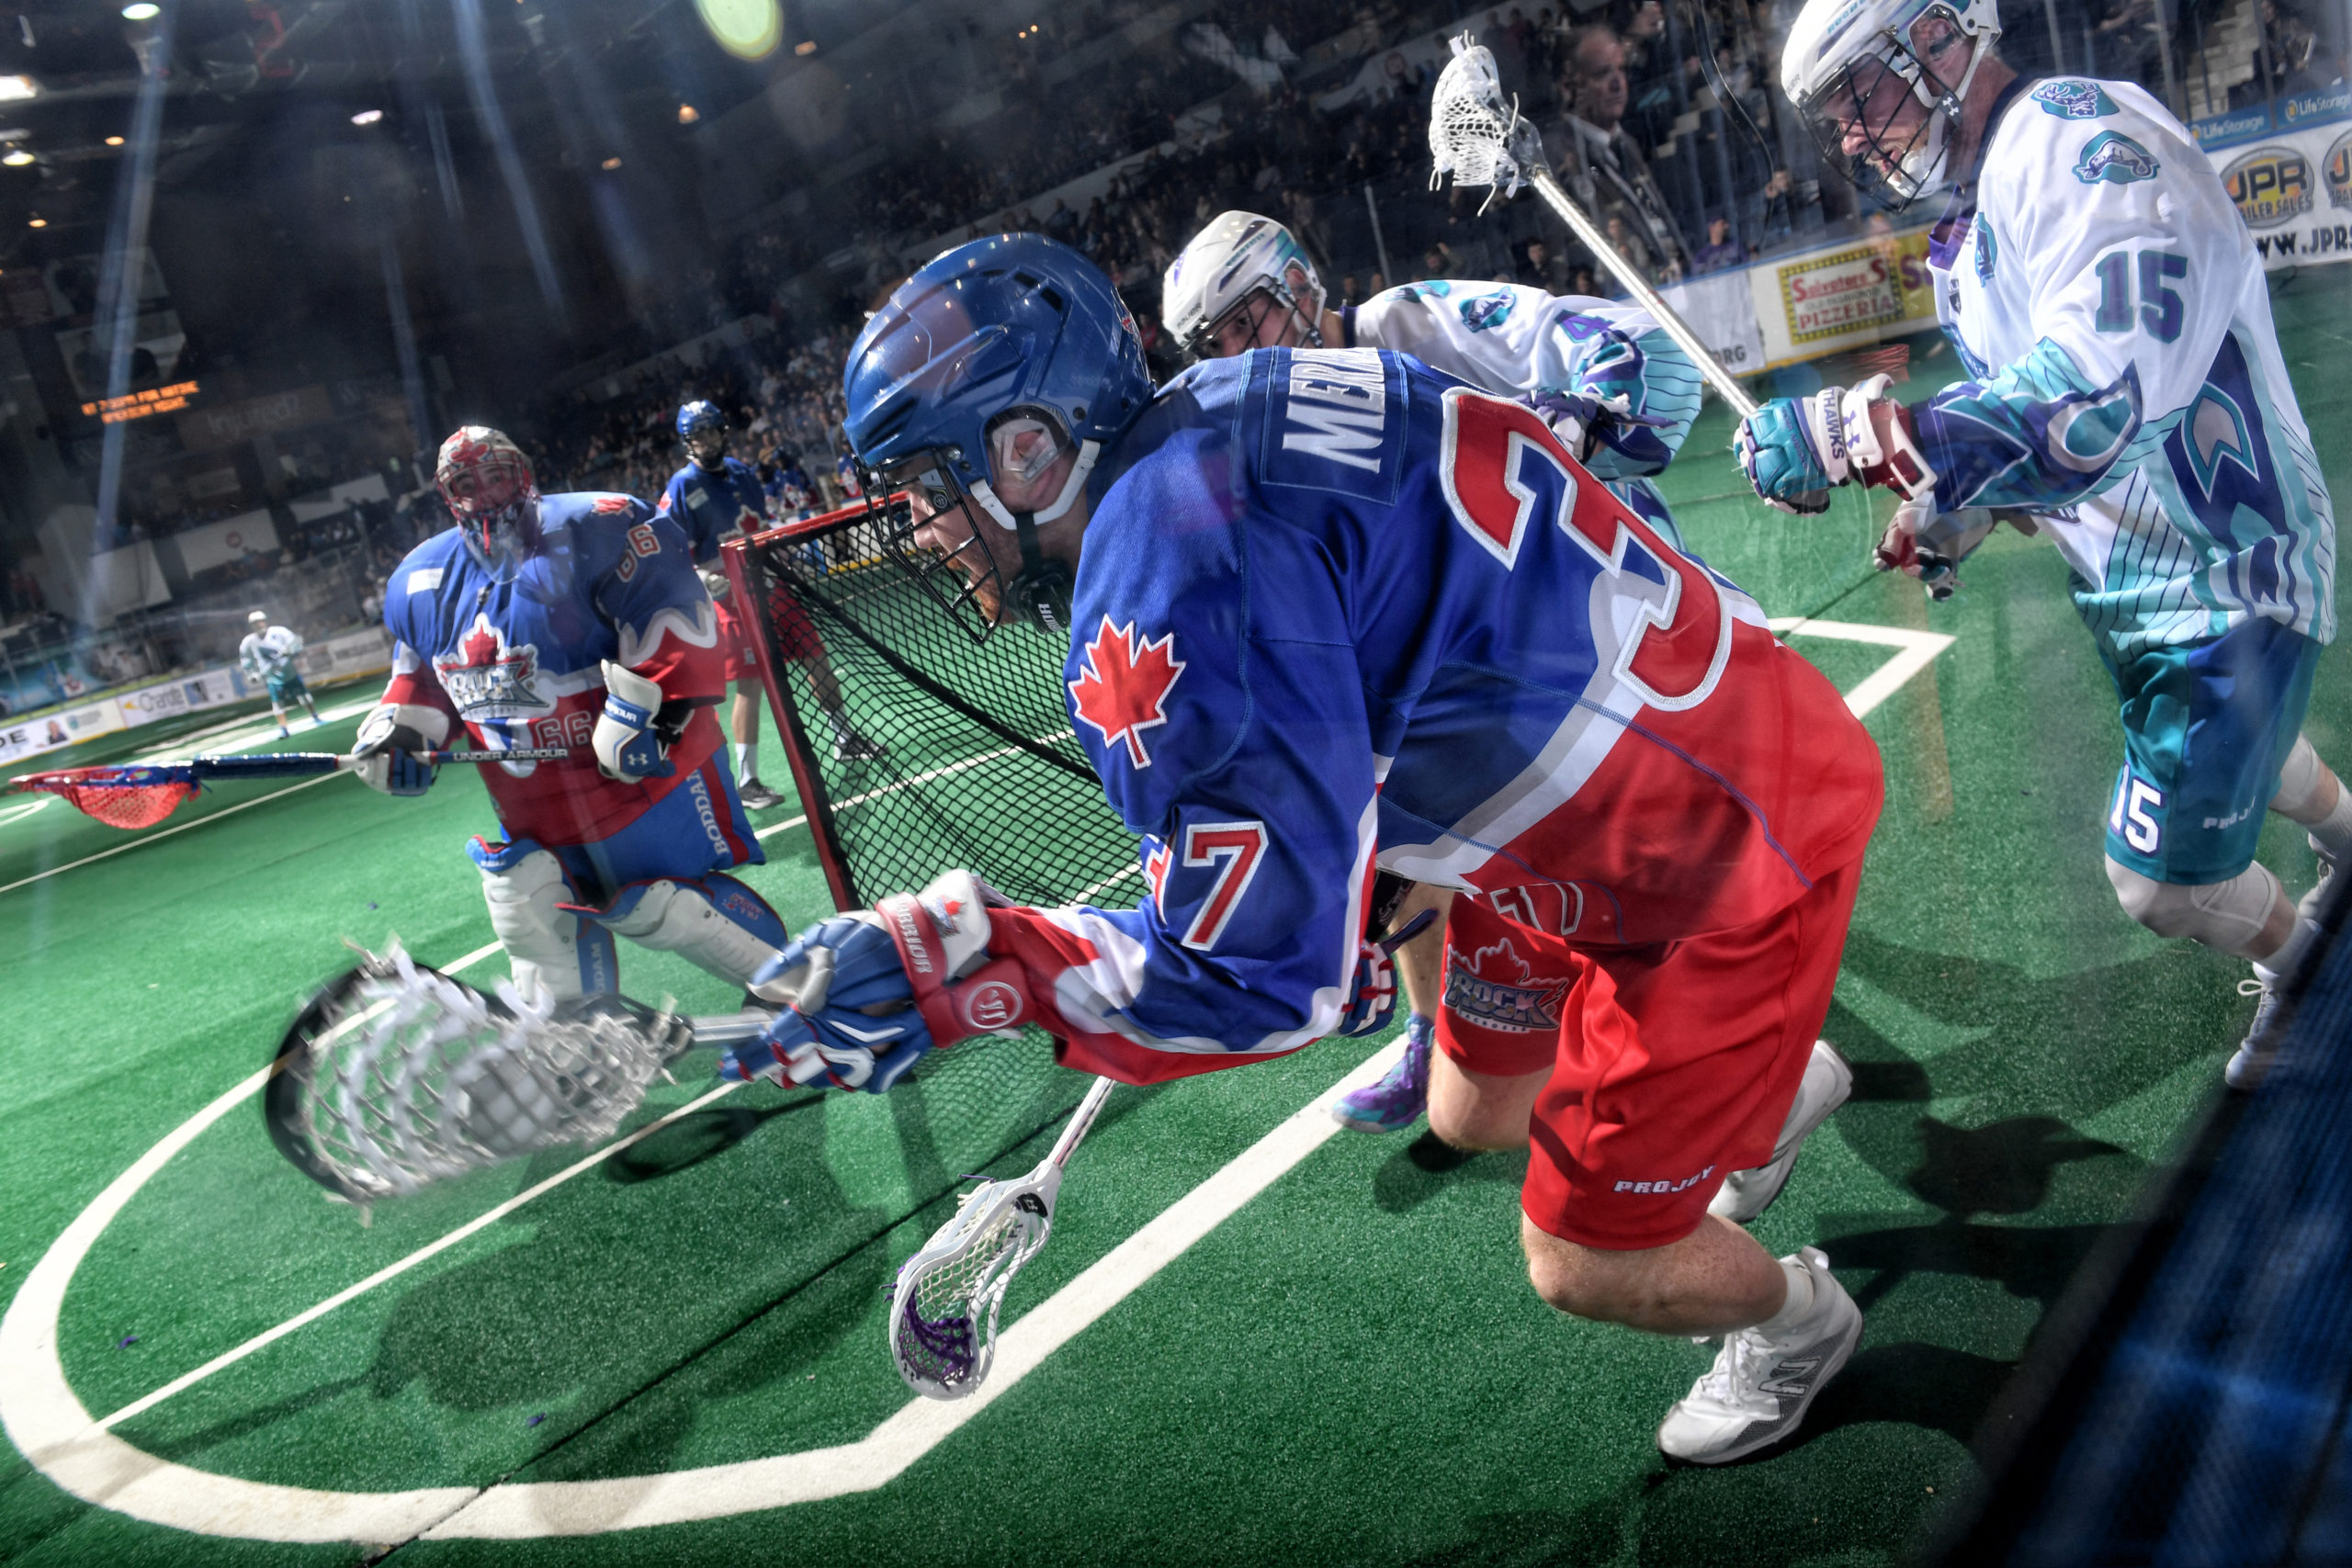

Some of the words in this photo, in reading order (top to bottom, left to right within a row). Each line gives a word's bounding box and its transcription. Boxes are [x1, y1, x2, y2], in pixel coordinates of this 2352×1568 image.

[2233, 157, 2307, 203] JPR
[1800, 294, 1893, 330] PIZZERIA
[2095, 250, 2188, 344] 15
[453, 750, 503, 761] UNDER
[507, 748, 568, 760] ARMOUR
[2109, 761, 2168, 858] 15
[1445, 964, 1553, 1027] ROCK
